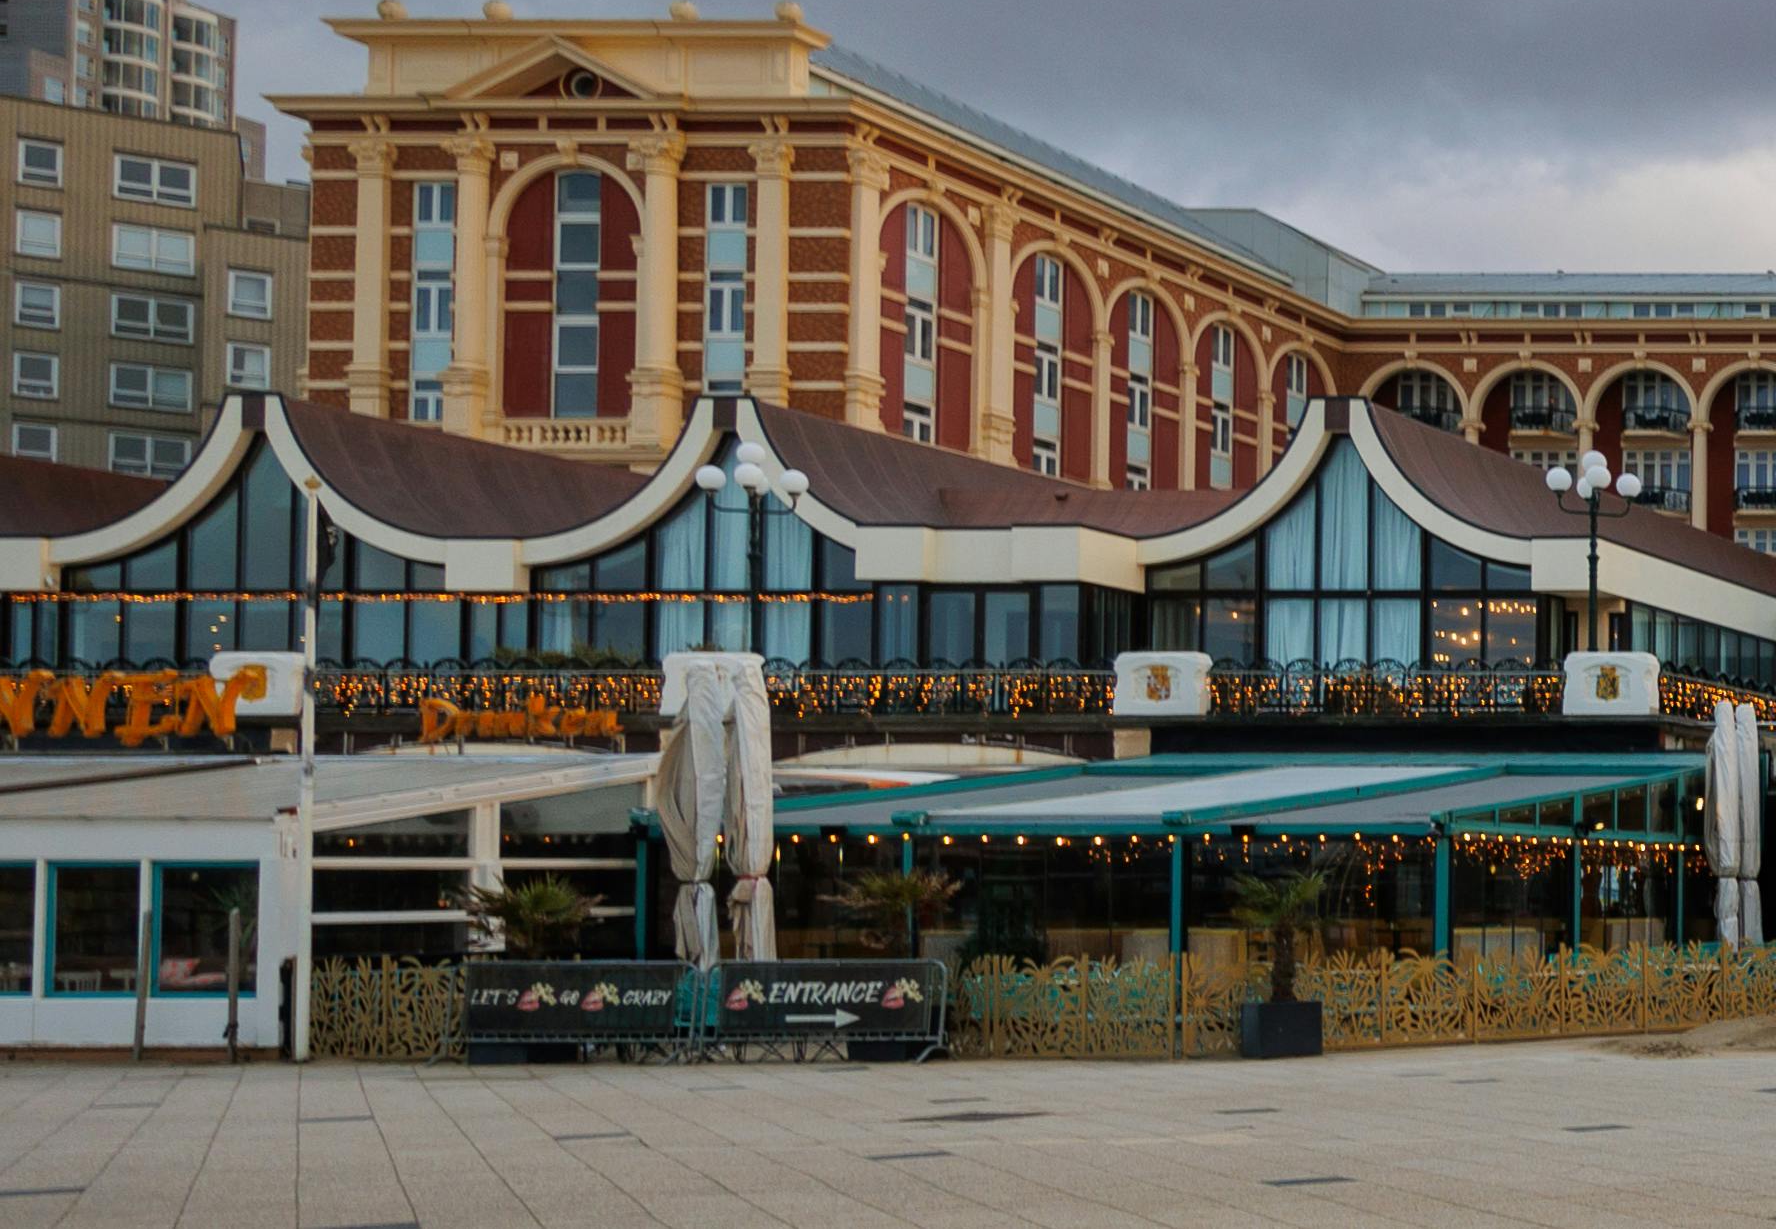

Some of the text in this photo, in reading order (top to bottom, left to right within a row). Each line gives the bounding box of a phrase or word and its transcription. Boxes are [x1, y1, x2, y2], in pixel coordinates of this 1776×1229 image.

[471, 988, 519, 1006] LET'S
[559, 990, 581, 1007] GO
[622, 989, 673, 1007] CRAZY
[769, 980, 884, 1005] ENTRANCE
